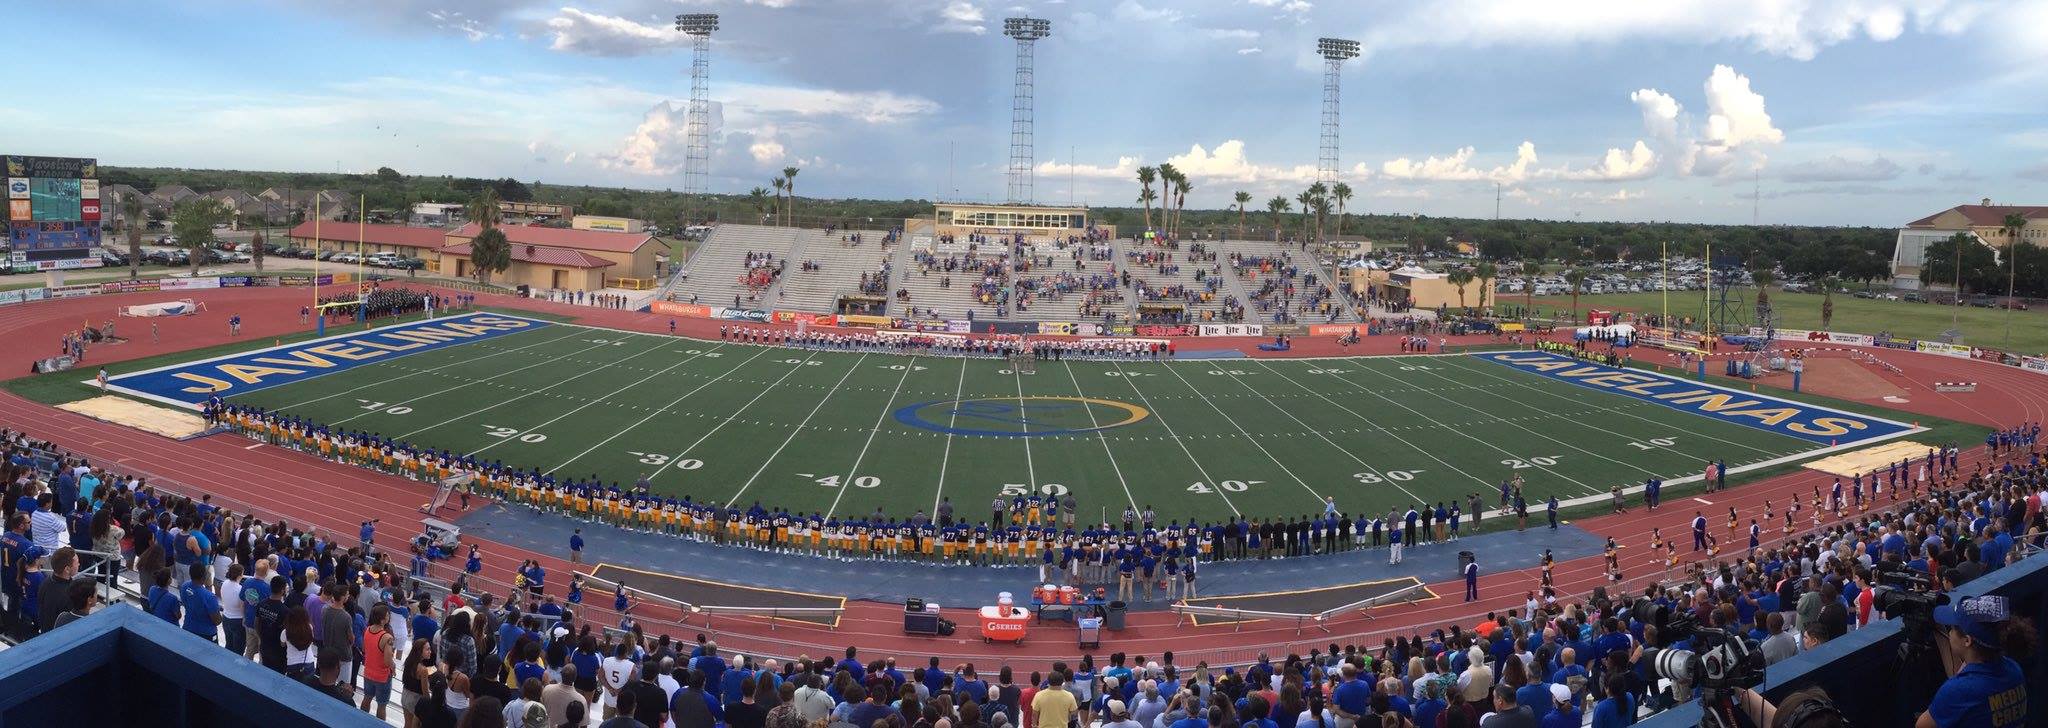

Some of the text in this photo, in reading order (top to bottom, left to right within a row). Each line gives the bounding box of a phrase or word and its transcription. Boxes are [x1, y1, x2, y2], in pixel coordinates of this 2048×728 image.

[723, 309, 741, 317] BUD
[742, 310, 772, 319] LIGHT
[1205, 325, 1219, 335] Lite
[1225, 325, 1240, 335] Lite
[1246, 325, 1260, 335] Lite
[171, 315, 532, 395] JAVELINAS
[1494, 353, 1869, 437] JAVELINAS
[359, 401, 413, 415] 10
[487, 427, 547, 443] 20
[1627, 438, 1675, 450] 10
[638, 453, 704, 470] 30
[1501, 456, 1558, 469] 20
[815, 474, 881, 488] 40
[1353, 470, 1414, 483] 30
[1002, 483, 1069, 496] 50
[1186, 480, 1248, 494] 40
[611, 671, 619, 683] 5
[1988, 685, 2026, 711] MEDIA
